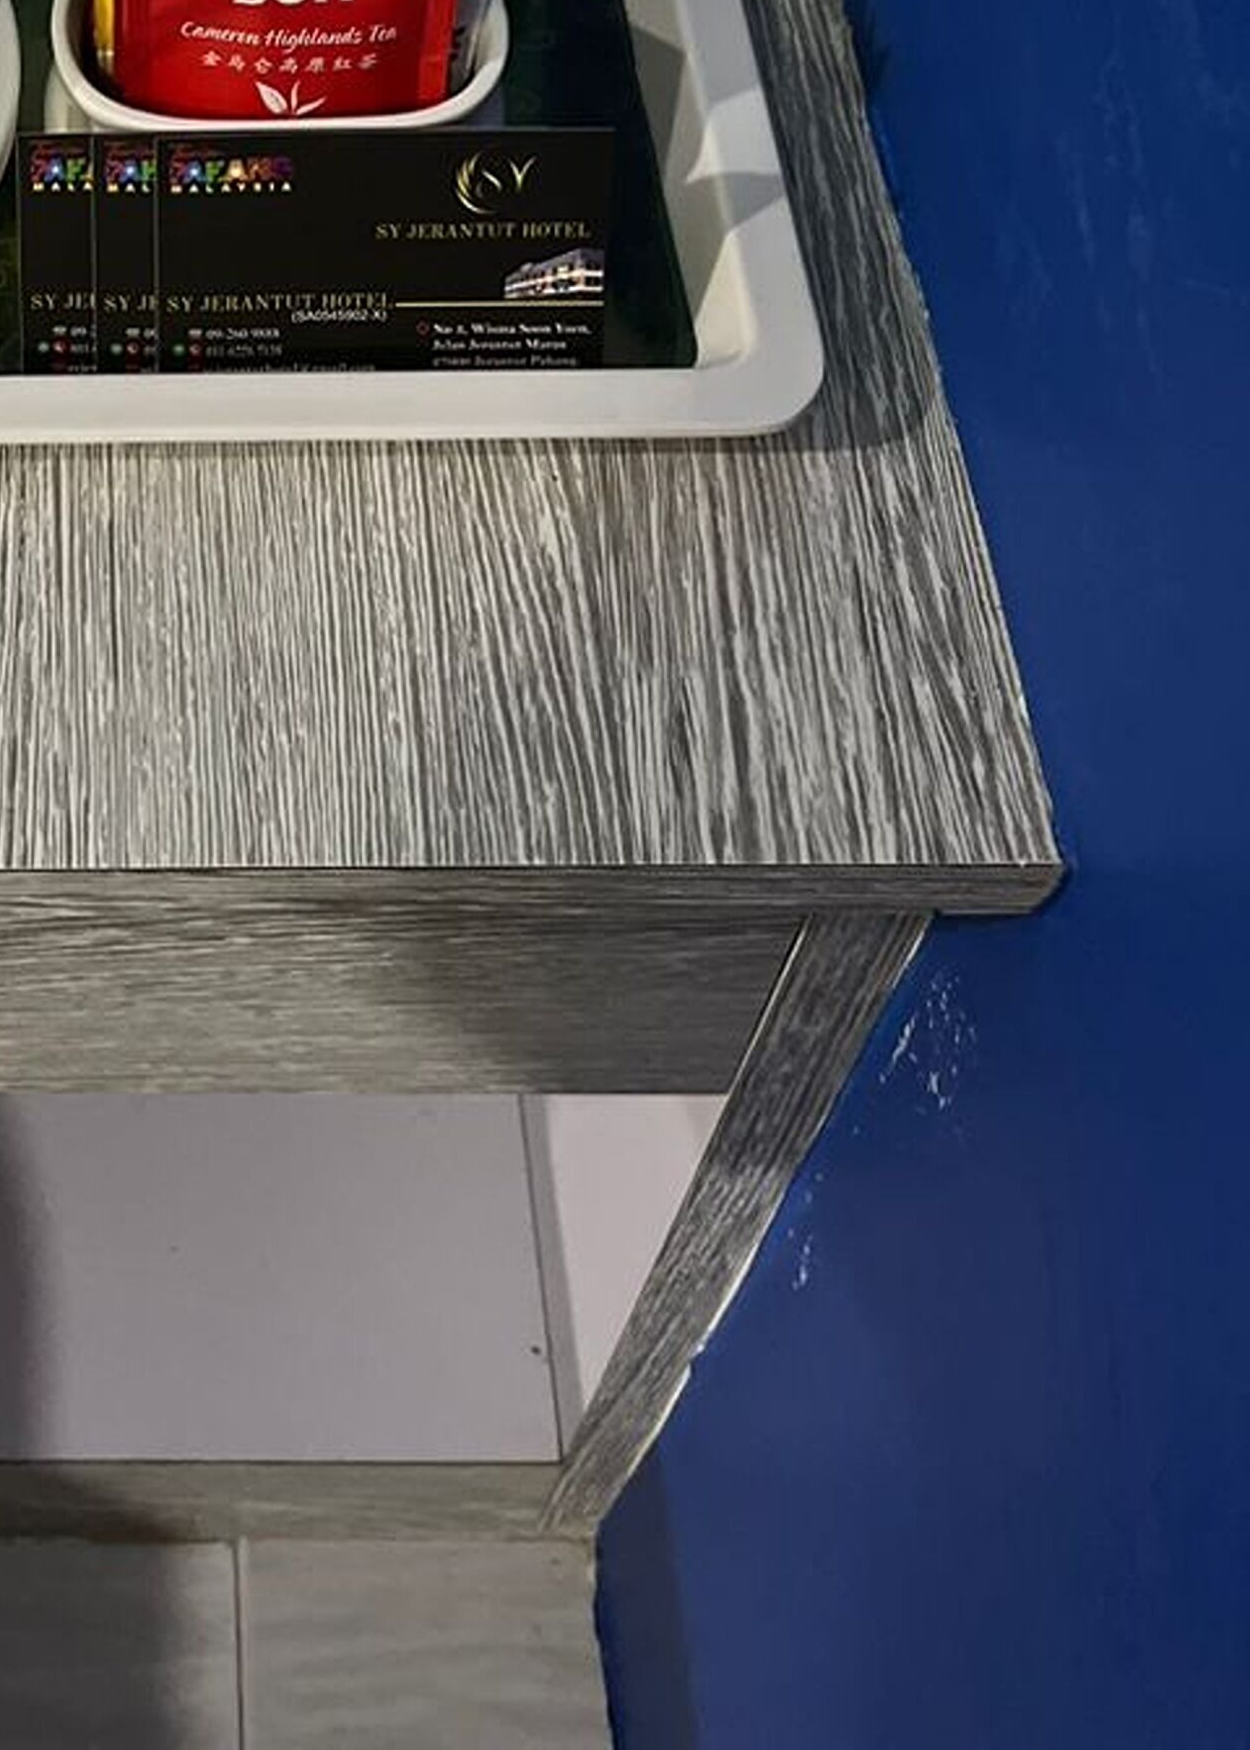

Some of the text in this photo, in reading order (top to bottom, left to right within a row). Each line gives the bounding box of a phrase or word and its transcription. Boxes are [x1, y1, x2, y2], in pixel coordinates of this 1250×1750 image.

[180, 21, 398, 54] Cameron Highlands Tea
[171, 182, 291, 194] MALAYSIA
[374, 221, 592, 240] SY JERANTUT HOTEL
[30, 293, 55, 310] SY
[103, 293, 131, 312] SY
[166, 291, 389, 313] SY JERANTUT HOTEL
